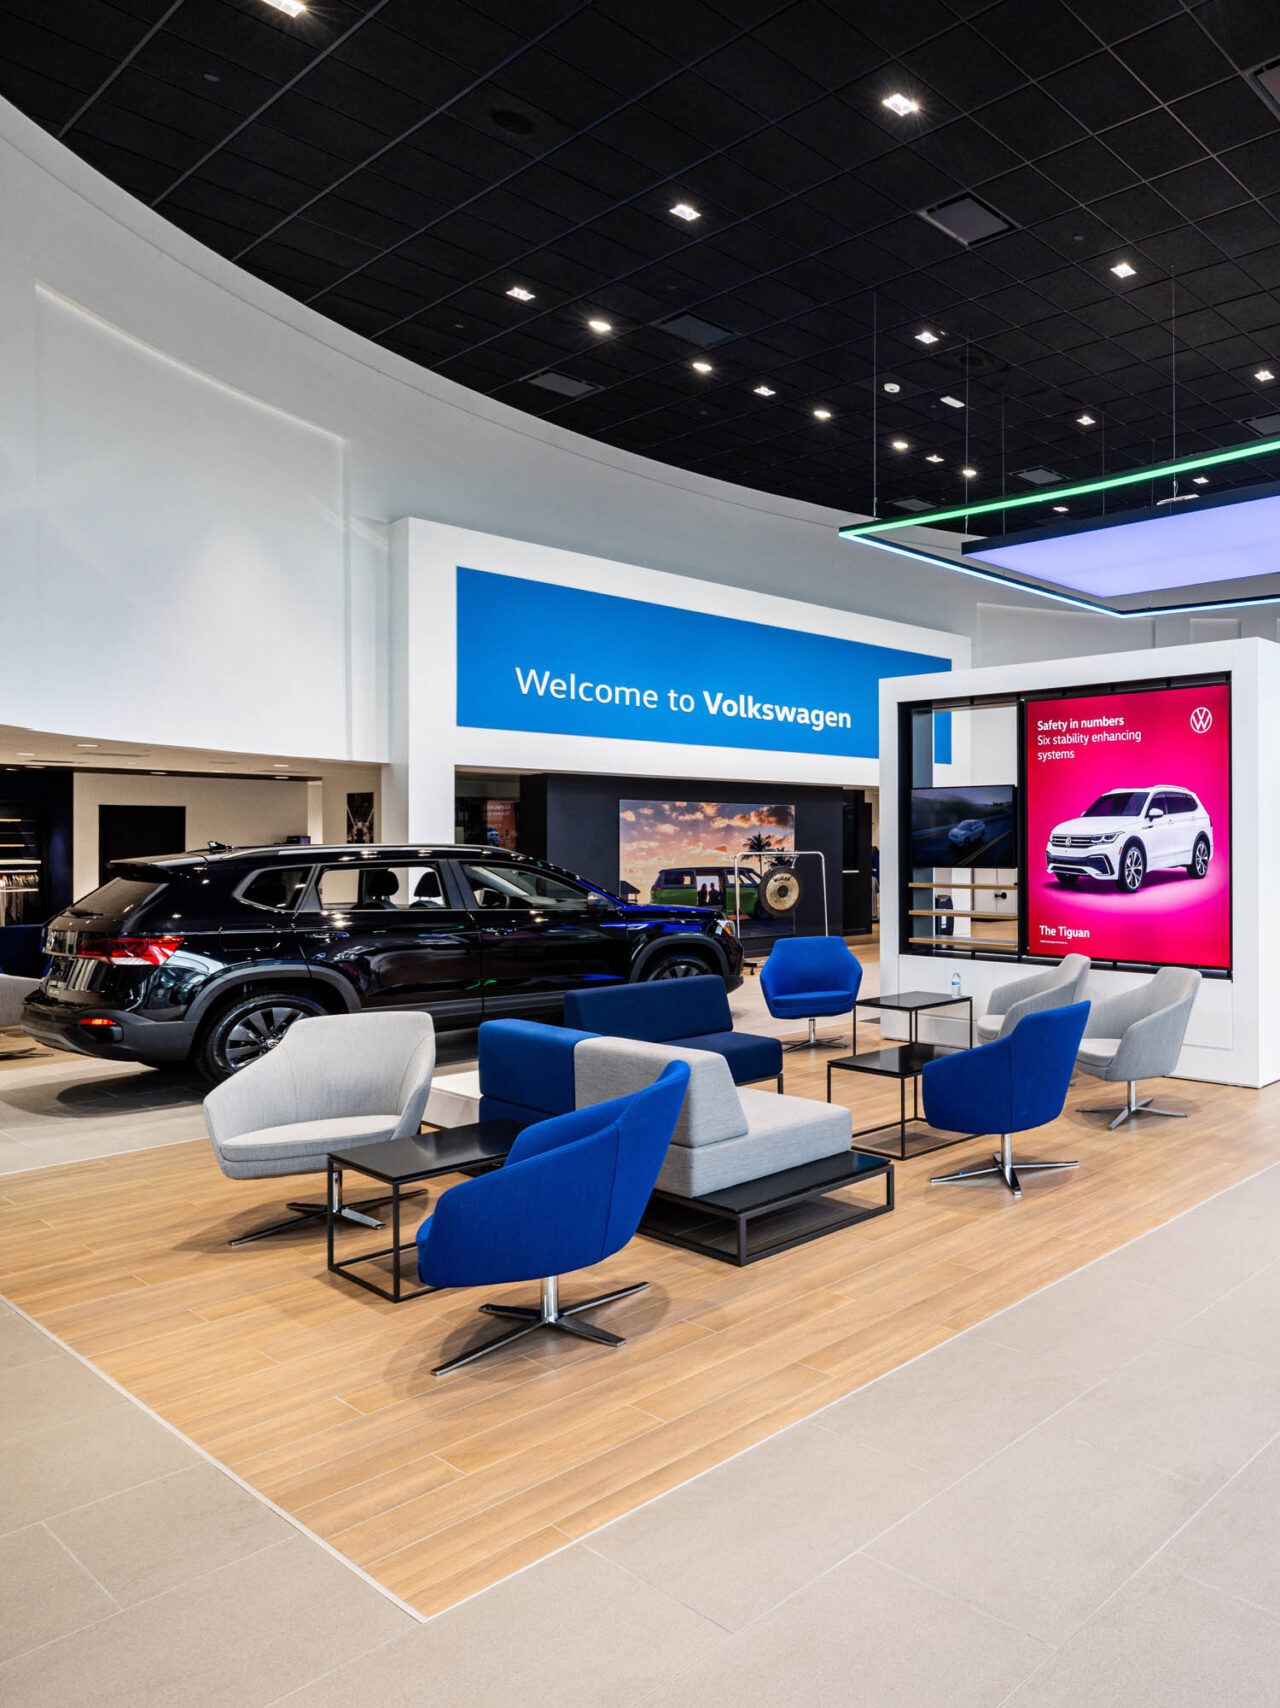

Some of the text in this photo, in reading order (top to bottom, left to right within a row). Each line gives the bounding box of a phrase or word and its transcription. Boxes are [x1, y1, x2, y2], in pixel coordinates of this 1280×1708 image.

[515, 667, 851, 731] Welcome to Volkswagen
[1037, 716, 1125, 733] Safety in numbers
[1037, 730, 1142, 746] Six stability enhancing
[1037, 750, 1075, 763] systems
[1039, 925, 1090, 939] The Tiguan
